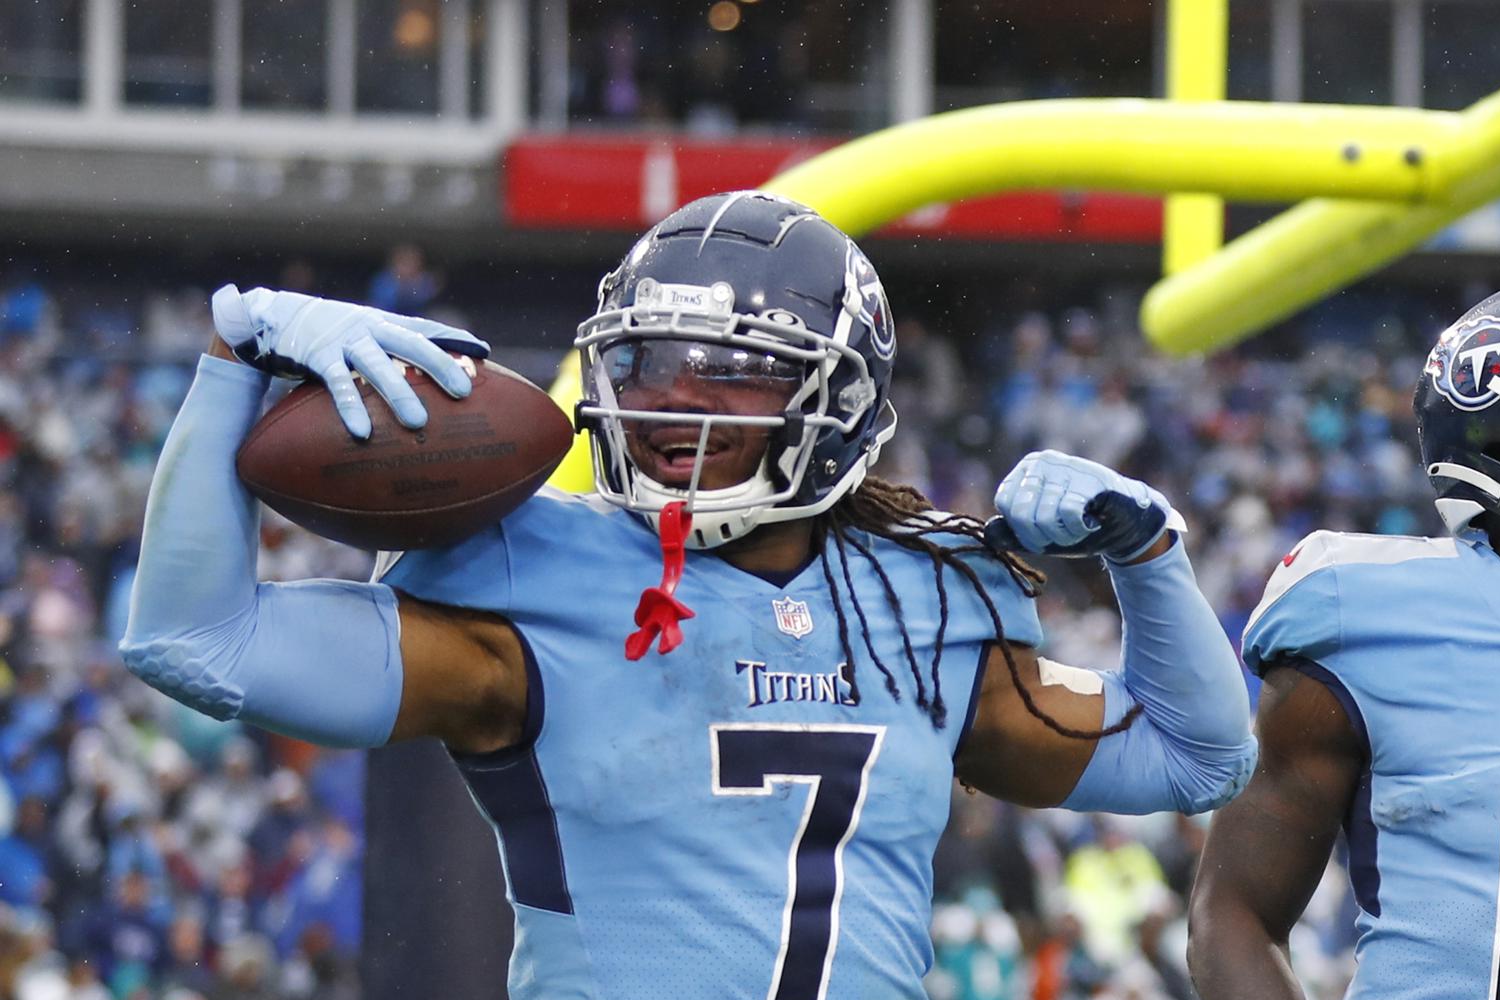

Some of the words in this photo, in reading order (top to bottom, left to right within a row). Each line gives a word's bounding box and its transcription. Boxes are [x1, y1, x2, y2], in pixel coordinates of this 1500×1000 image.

[671, 290, 703, 306] TITANS
[783, 612, 808, 629] NFL
[735, 660, 860, 708] TITANS
